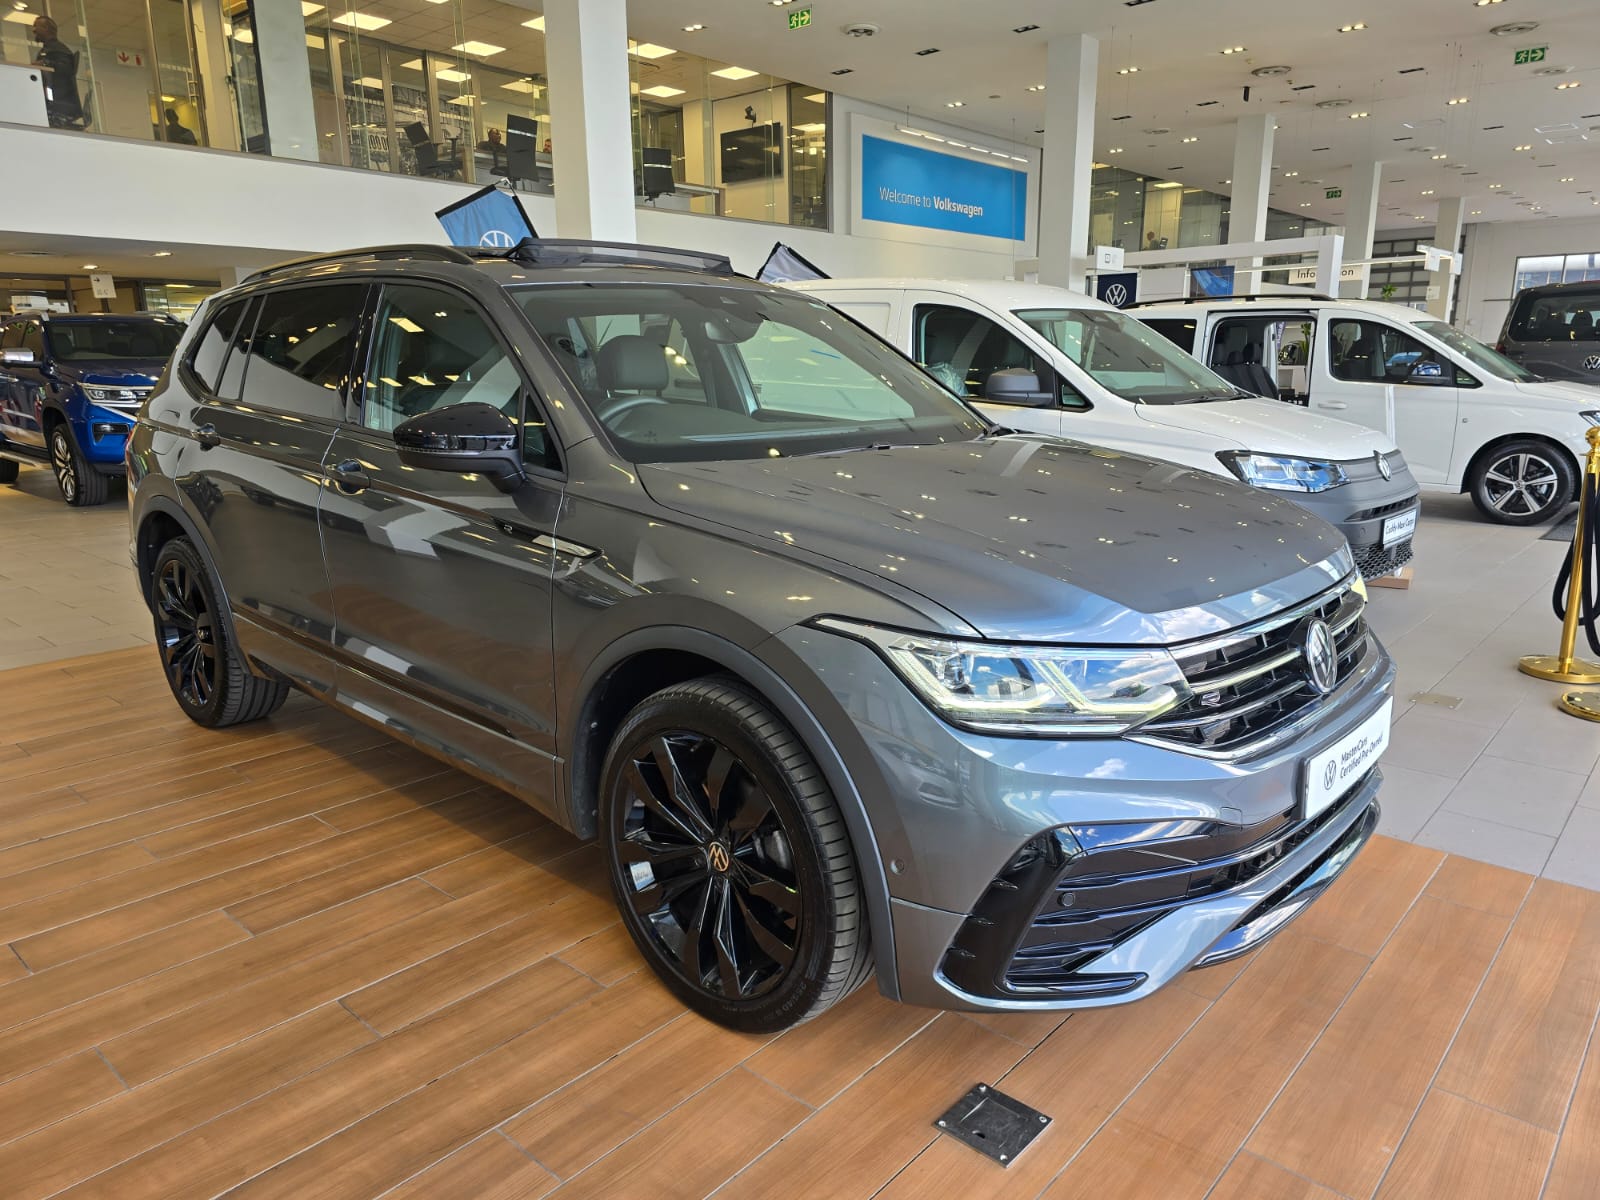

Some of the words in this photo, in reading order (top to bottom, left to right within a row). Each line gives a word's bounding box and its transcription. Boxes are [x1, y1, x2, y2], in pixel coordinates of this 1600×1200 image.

[879, 186, 921, 208] Welcome
[923, 195, 932, 209] to
[933, 195, 984, 218] Volkswagen
[1339, 754, 1362, 780] Certified
